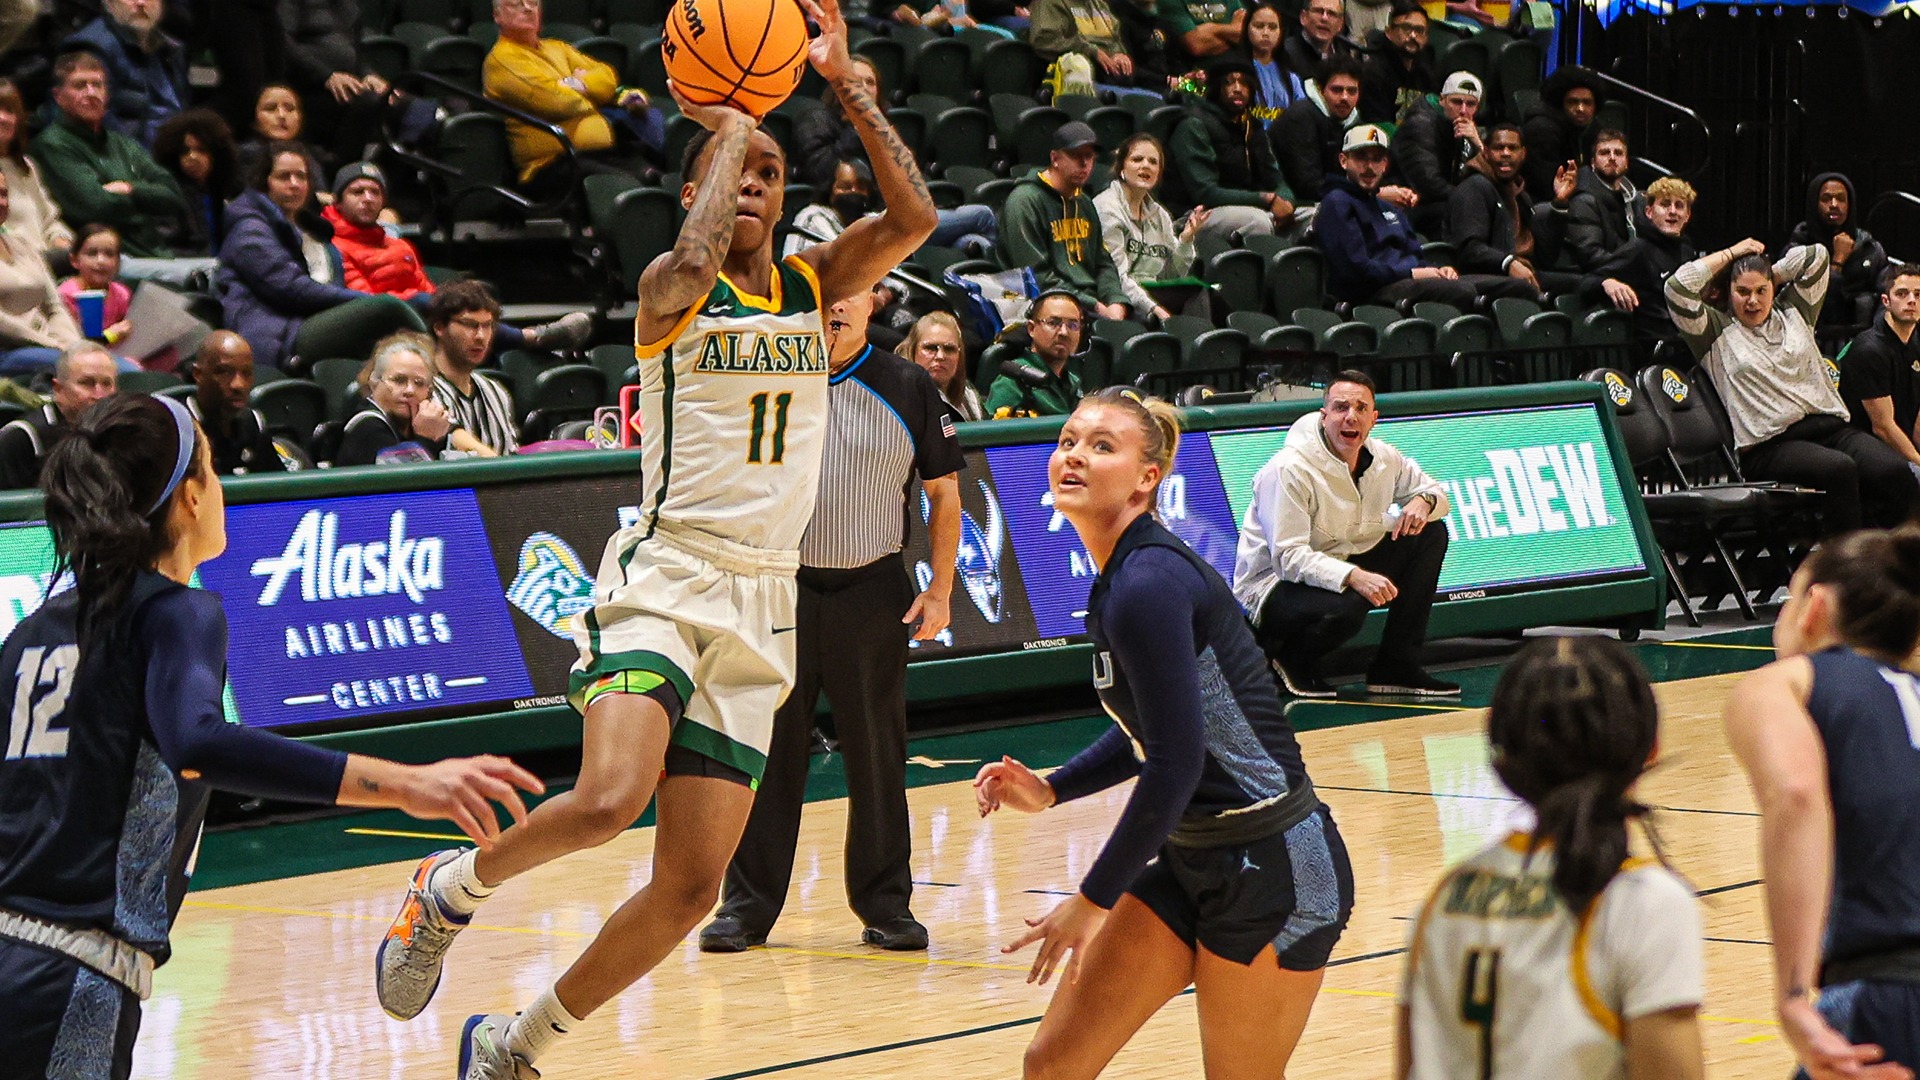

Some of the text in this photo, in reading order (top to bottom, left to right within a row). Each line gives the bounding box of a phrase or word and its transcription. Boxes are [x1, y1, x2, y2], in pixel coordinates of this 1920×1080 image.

[695, 332, 828, 374] ALASKA
[747, 391, 793, 465] 11
[250, 508, 445, 605] Alaska
[284, 611, 453, 659] AIRLINES
[4, 643, 80, 761] 12
[330, 672, 444, 709] CENTER
[1460, 947, 1502, 1080] 4
